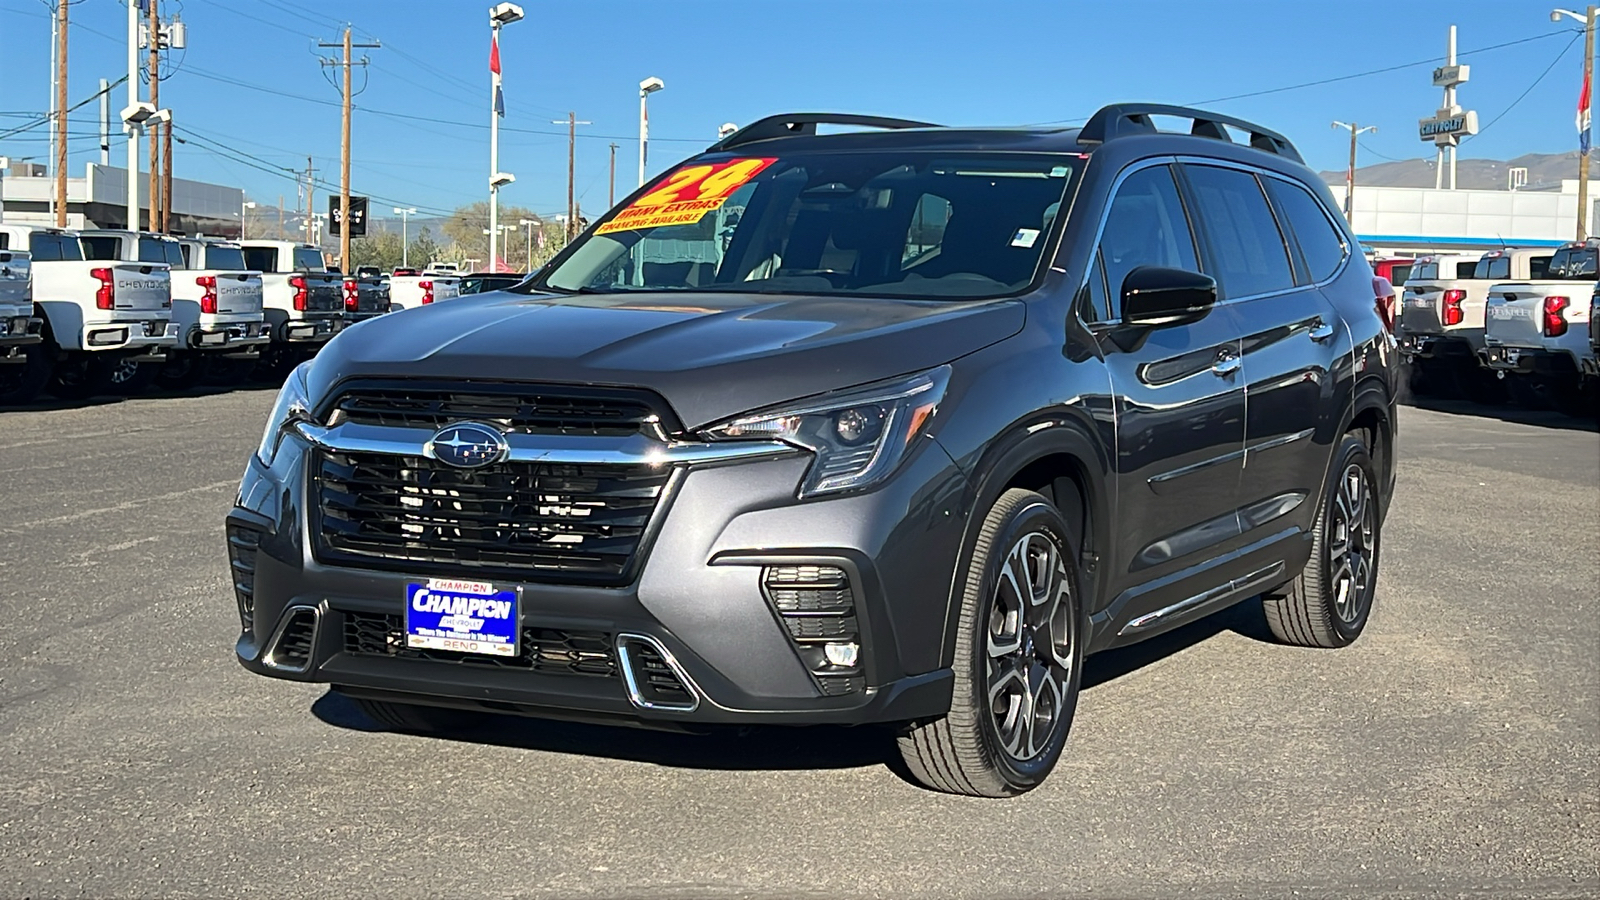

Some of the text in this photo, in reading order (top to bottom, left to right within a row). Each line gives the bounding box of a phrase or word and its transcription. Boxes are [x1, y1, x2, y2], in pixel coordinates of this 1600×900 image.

[1420, 118, 1464, 135] CHEVROLET
[634, 159, 764, 207] 24
[616, 199, 724, 221] MANY EXTRAS
[597, 212, 702, 233] FINANCING AVAILABLE
[434, 580, 488, 593] CHAMPION
[412, 589, 511, 620] CHAMPION
[442, 618, 480, 628] CHEVROLET
[443, 640, 478, 651] RENO
